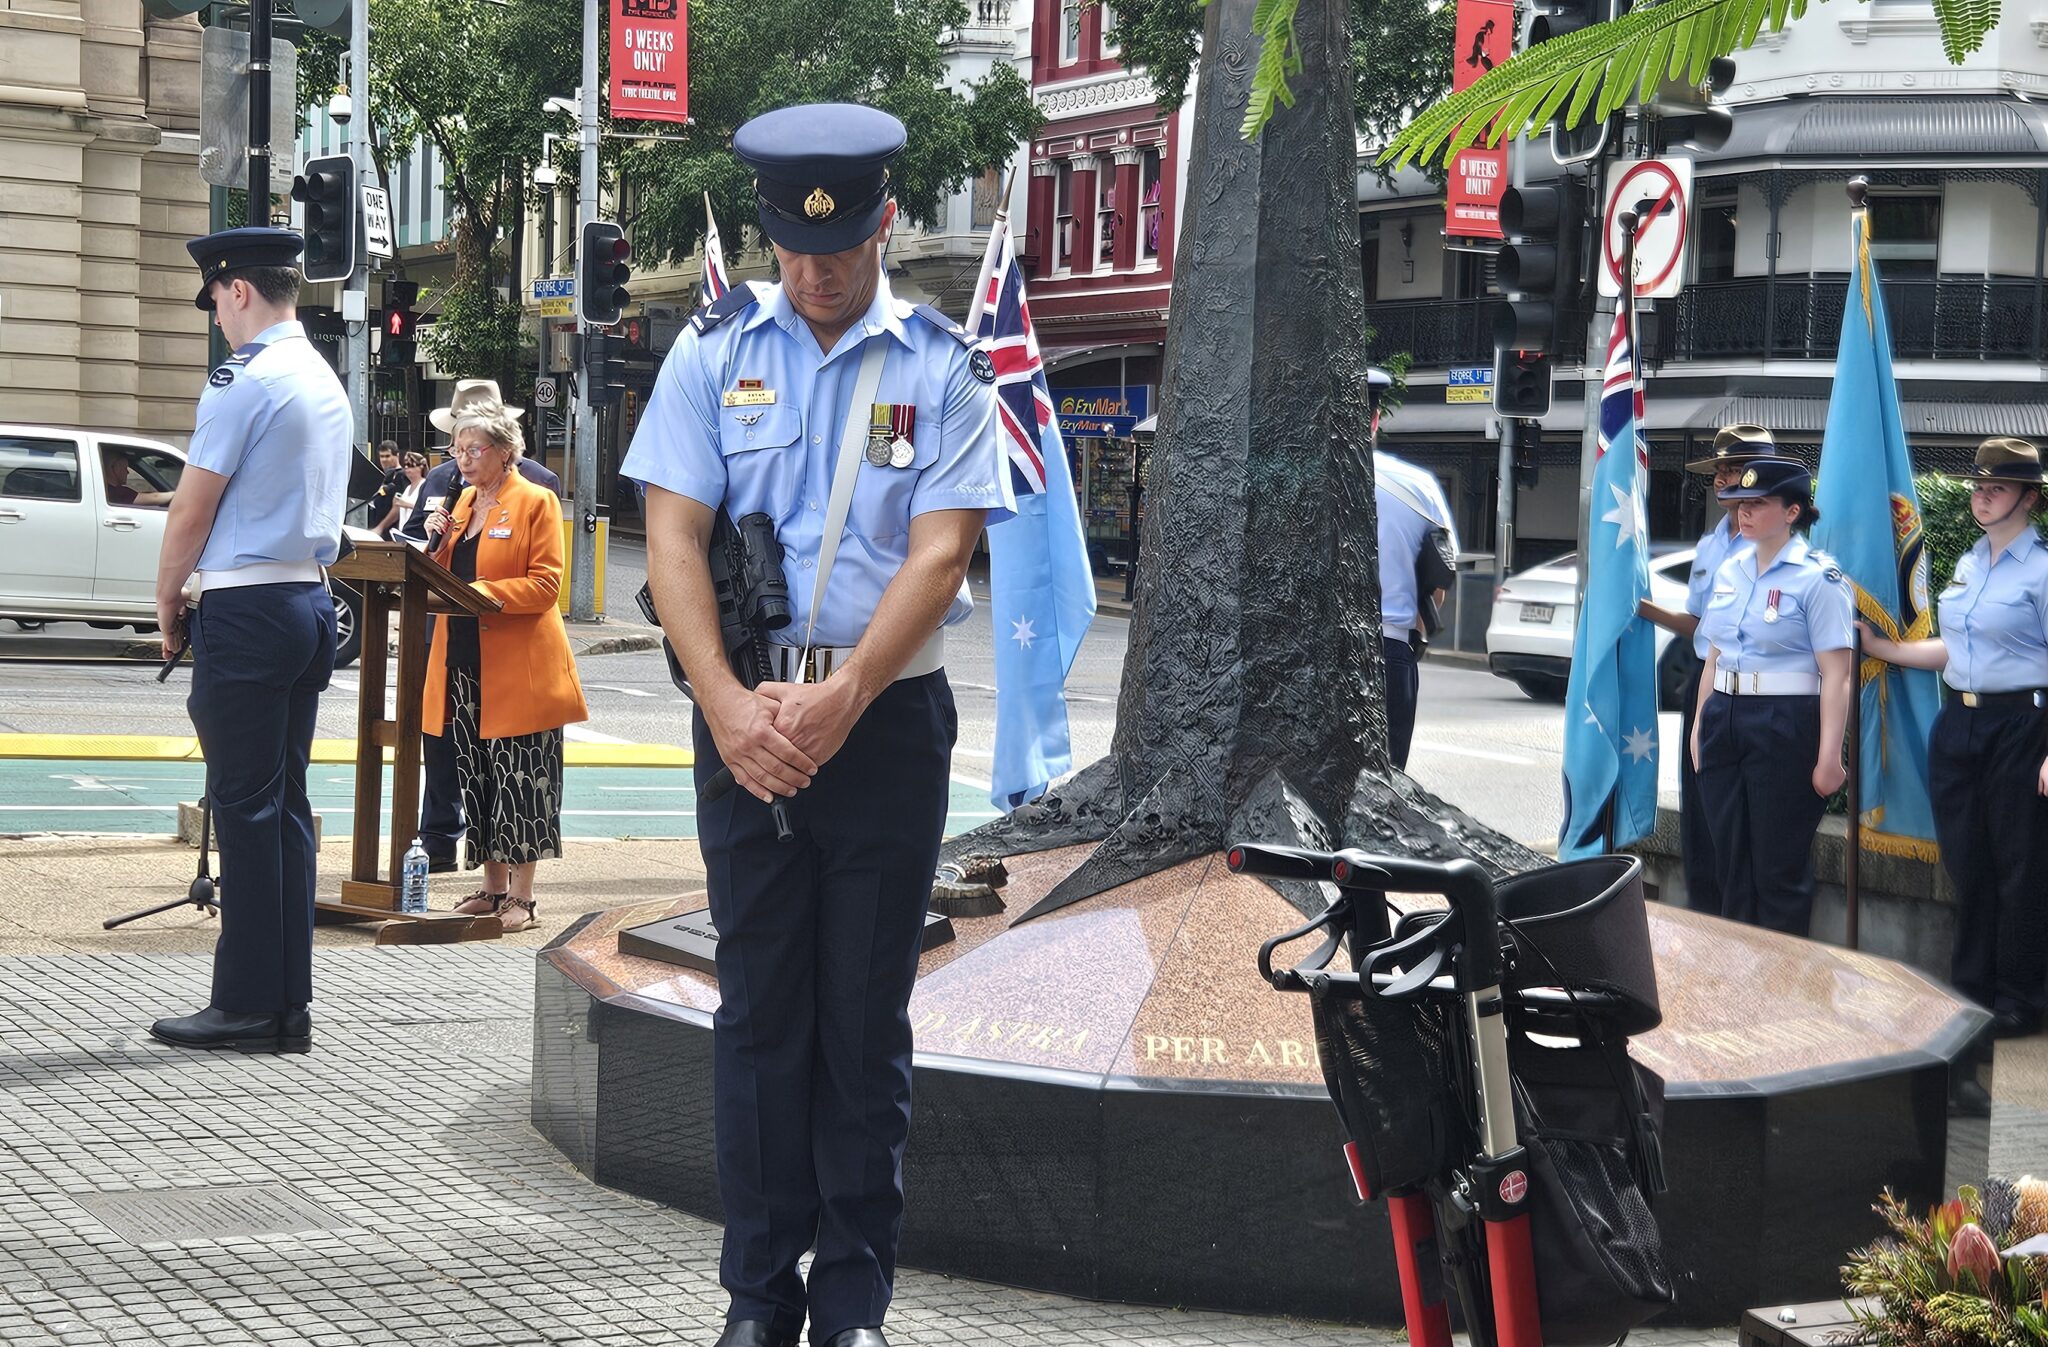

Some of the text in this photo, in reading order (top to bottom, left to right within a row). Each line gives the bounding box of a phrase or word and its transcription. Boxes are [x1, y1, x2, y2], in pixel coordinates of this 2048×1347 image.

[625, 28, 674, 52] 8 WEEKS
[634, 50, 666, 73] ONLY!
[1460, 159, 1498, 178] 8 WEEKS
[1465, 177, 1491, 196] ONLY!
[366, 192, 385, 210] ONE
[367, 213, 387, 231] WAY
[538, 386, 553, 398] 40
[910, 1011, 1089, 1057] D ASTRA
[1143, 1034, 1229, 1065] PER
